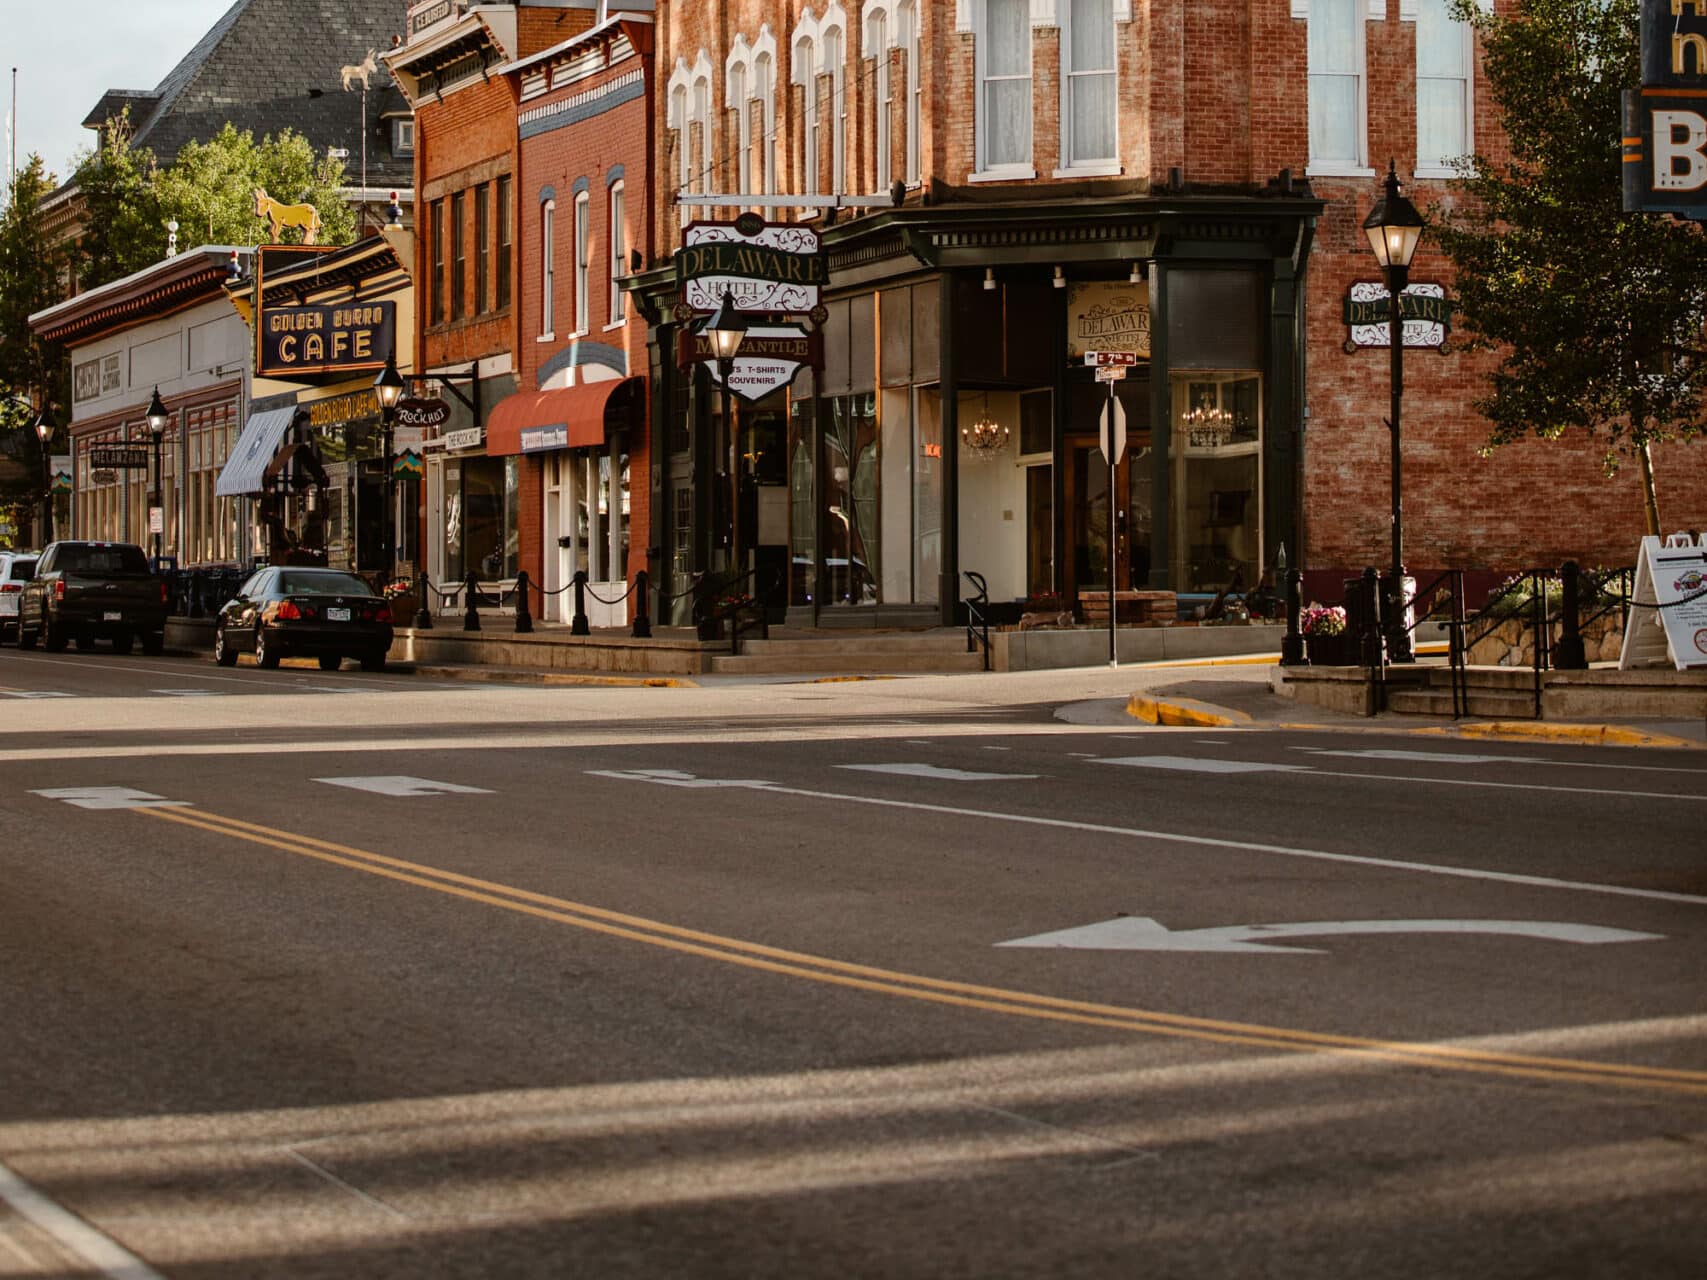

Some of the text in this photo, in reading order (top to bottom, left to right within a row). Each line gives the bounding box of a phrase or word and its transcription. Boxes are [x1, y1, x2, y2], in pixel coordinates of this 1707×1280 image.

[682, 245, 822, 281] DELAWARE
[708, 281, 763, 296] HOTEL
[271, 307, 383, 332] GOLDEN BURRO
[1350, 298, 1442, 321] DELAR
[1083, 314, 1148, 336] DELAWAR
[279, 329, 373, 363] CAFE
[695, 338, 809, 356] MCANTILE
[748, 366, 786, 374] T-SHIRTS
[728, 376, 776, 385] SOUVENIRS
[400, 407, 445, 424] ROCK HUT
